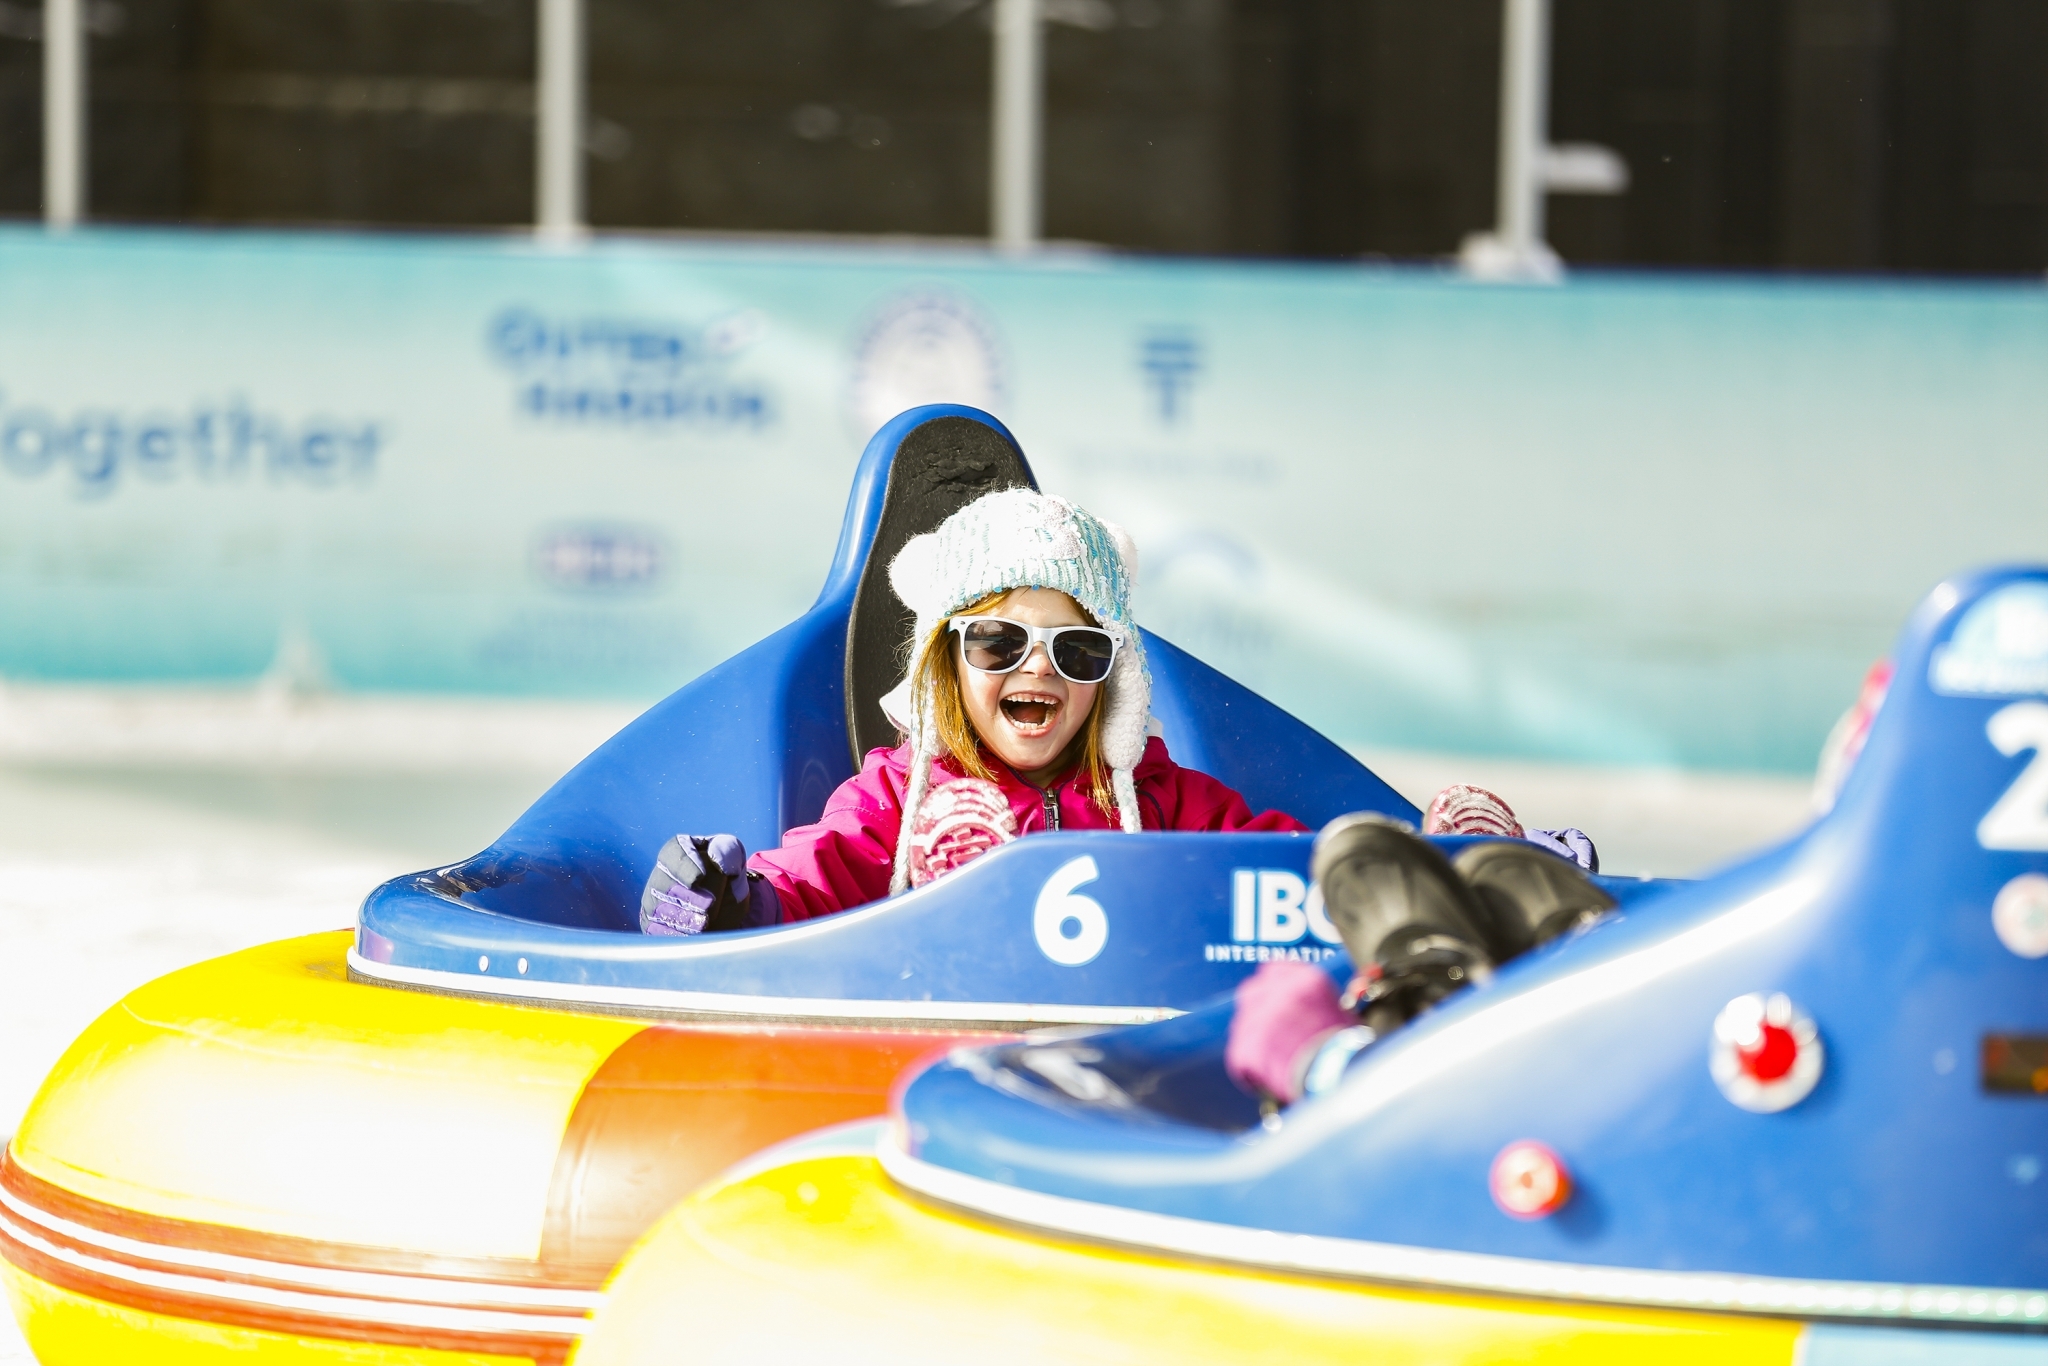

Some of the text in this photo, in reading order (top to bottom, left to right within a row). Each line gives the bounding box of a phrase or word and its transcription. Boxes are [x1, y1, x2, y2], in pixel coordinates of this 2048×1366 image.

[0, 392, 384, 500] ogether
[1973, 700, 2048, 851] 2
[1034, 855, 1109, 966] 6
